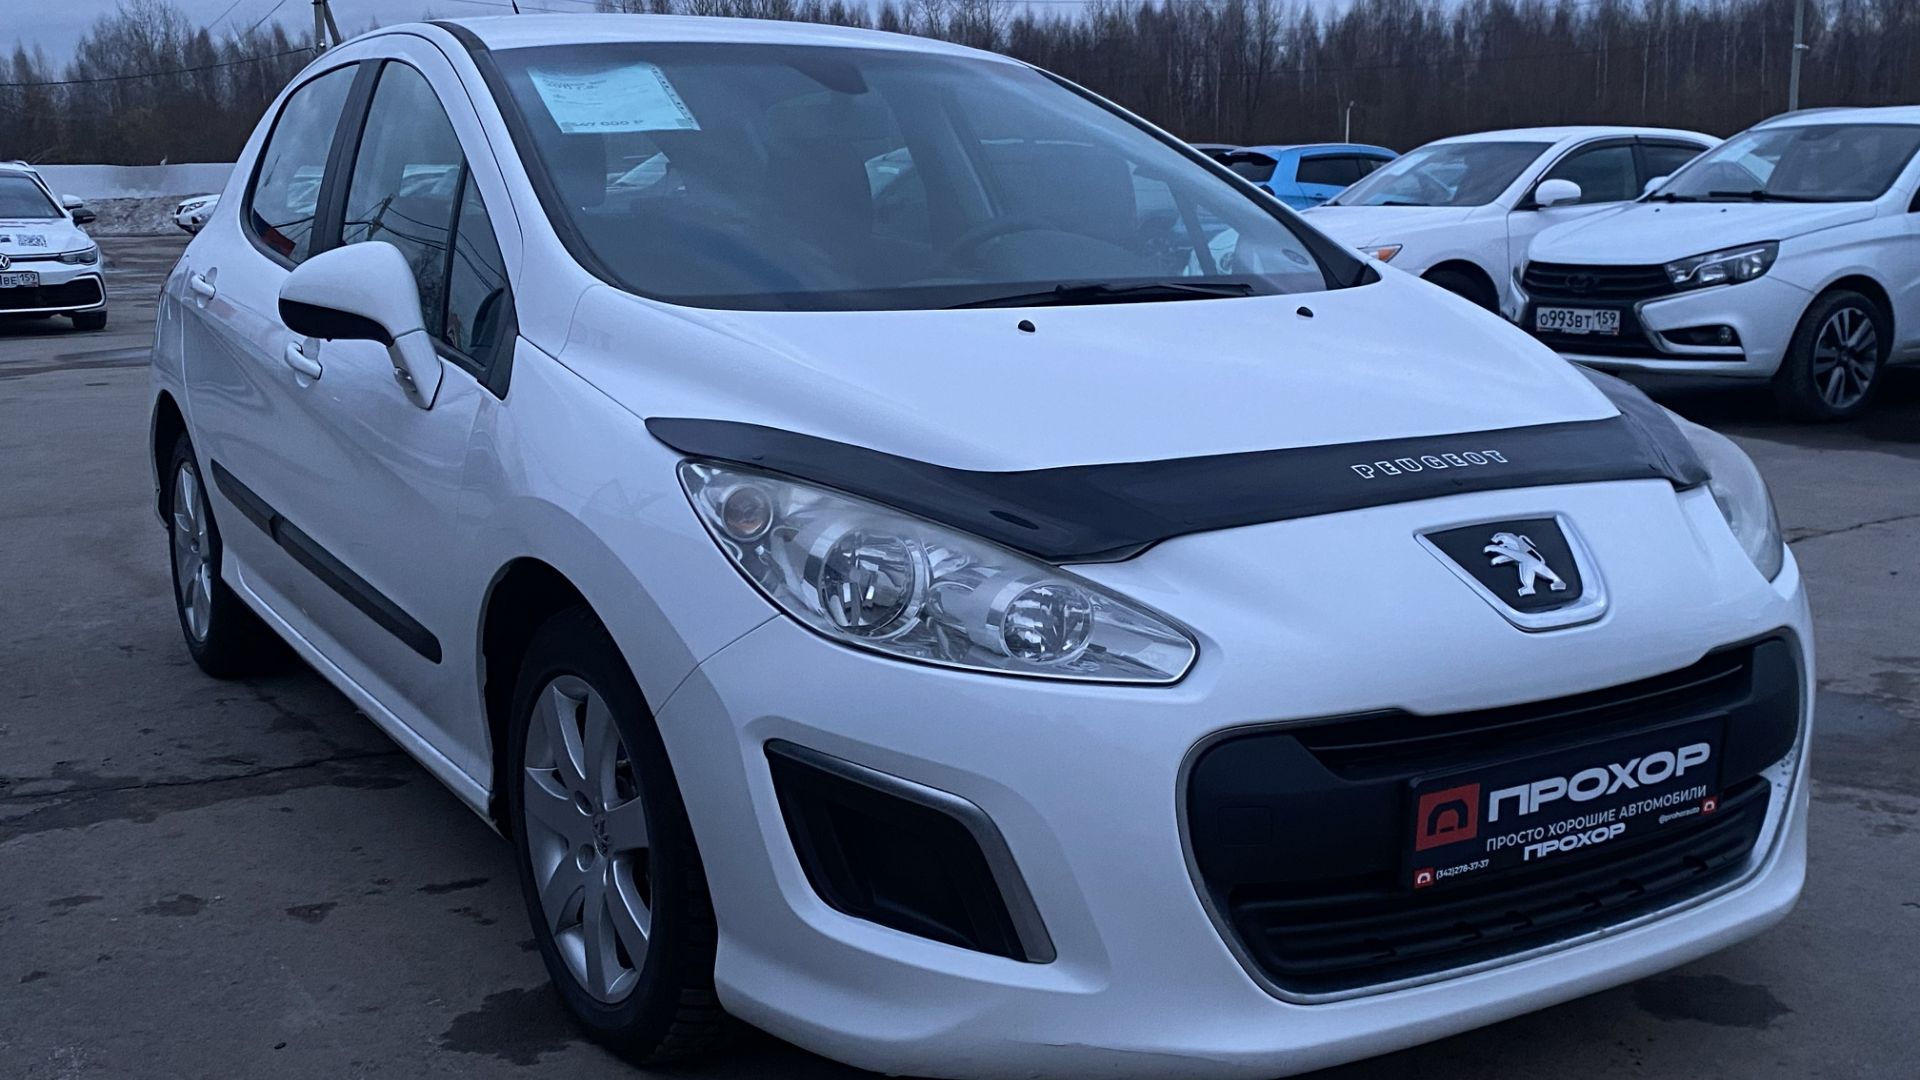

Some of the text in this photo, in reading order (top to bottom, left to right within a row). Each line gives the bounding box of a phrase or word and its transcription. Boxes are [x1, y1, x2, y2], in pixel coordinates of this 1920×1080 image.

[19, 273, 36, 282] 159
[1595, 311, 1617, 325] 159
[1351, 450, 1508, 479] PEUGEOT
[1488, 742, 1711, 822] ПРОХОР
[1486, 784, 1707, 852] ПРОСТО ХОРОШИЕ АВТОМОБИЛИ
[1523, 822, 1626, 861] ПРОХОР
